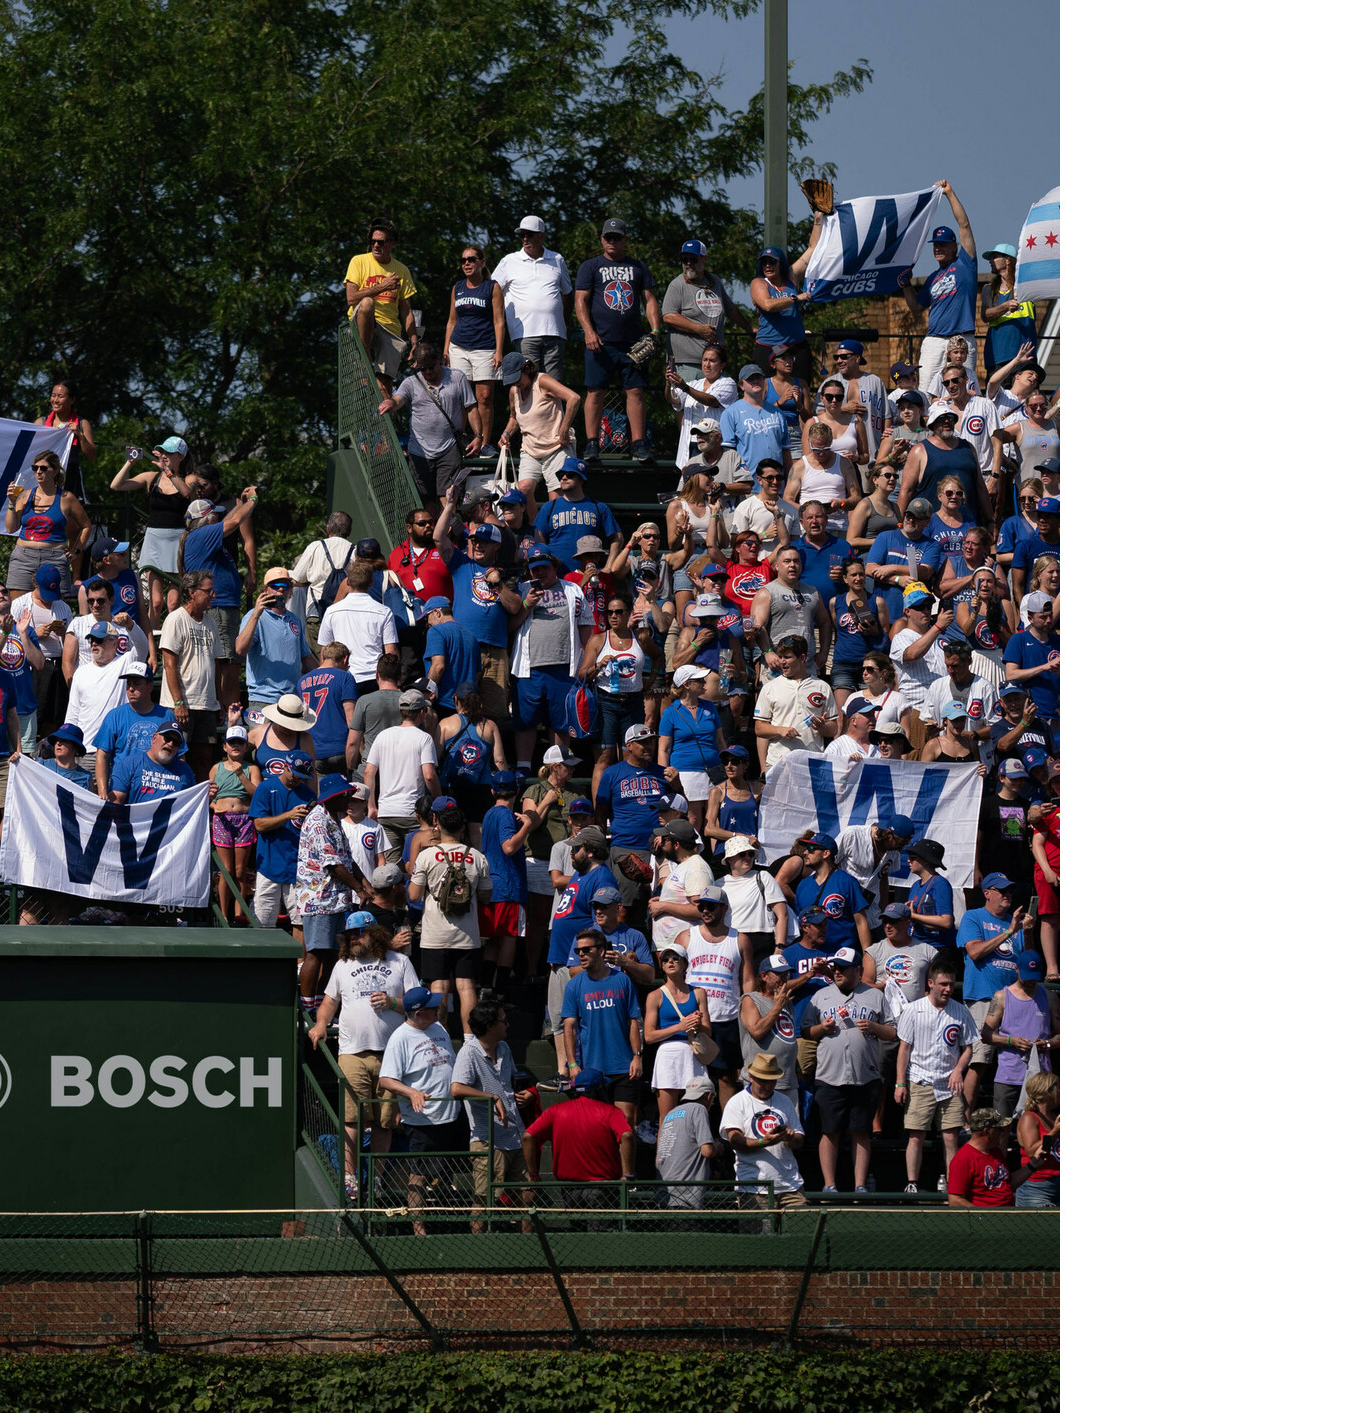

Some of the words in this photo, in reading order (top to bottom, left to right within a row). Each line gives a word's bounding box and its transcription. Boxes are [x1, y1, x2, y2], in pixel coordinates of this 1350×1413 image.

[835, 190, 934, 275] W
[599, 266, 634, 282] RUSH
[831, 279, 876, 296] CUBS
[1040, 499, 1050, 507] C
[552, 509, 597, 530] CHICAGO
[541, 590, 567, 605] UBS
[781, 595, 812, 604] CUBS
[300, 673, 335, 691] BRYANT
[303, 687, 329, 716] 17
[142, 769, 154, 777] THE
[154, 771, 181, 782] SUMMER
[621, 777, 660, 792] CUBS
[620, 789, 650, 799] BASEBALL
[808, 758, 949, 880] W
[56, 784, 177, 890] W
[435, 851, 474, 864] CUBS
[159, 906, 184, 914] 503
[691, 954, 717, 969] WRIGLEY
[719, 955, 735, 973] FIELD
[351, 965, 392, 978] CHICAGO
[584, 990, 606, 1002] END
[586, 1002, 594, 1010] 4
[595, 998, 617, 1009] LOU.
[50, 1054, 282, 1108] BOSCH
